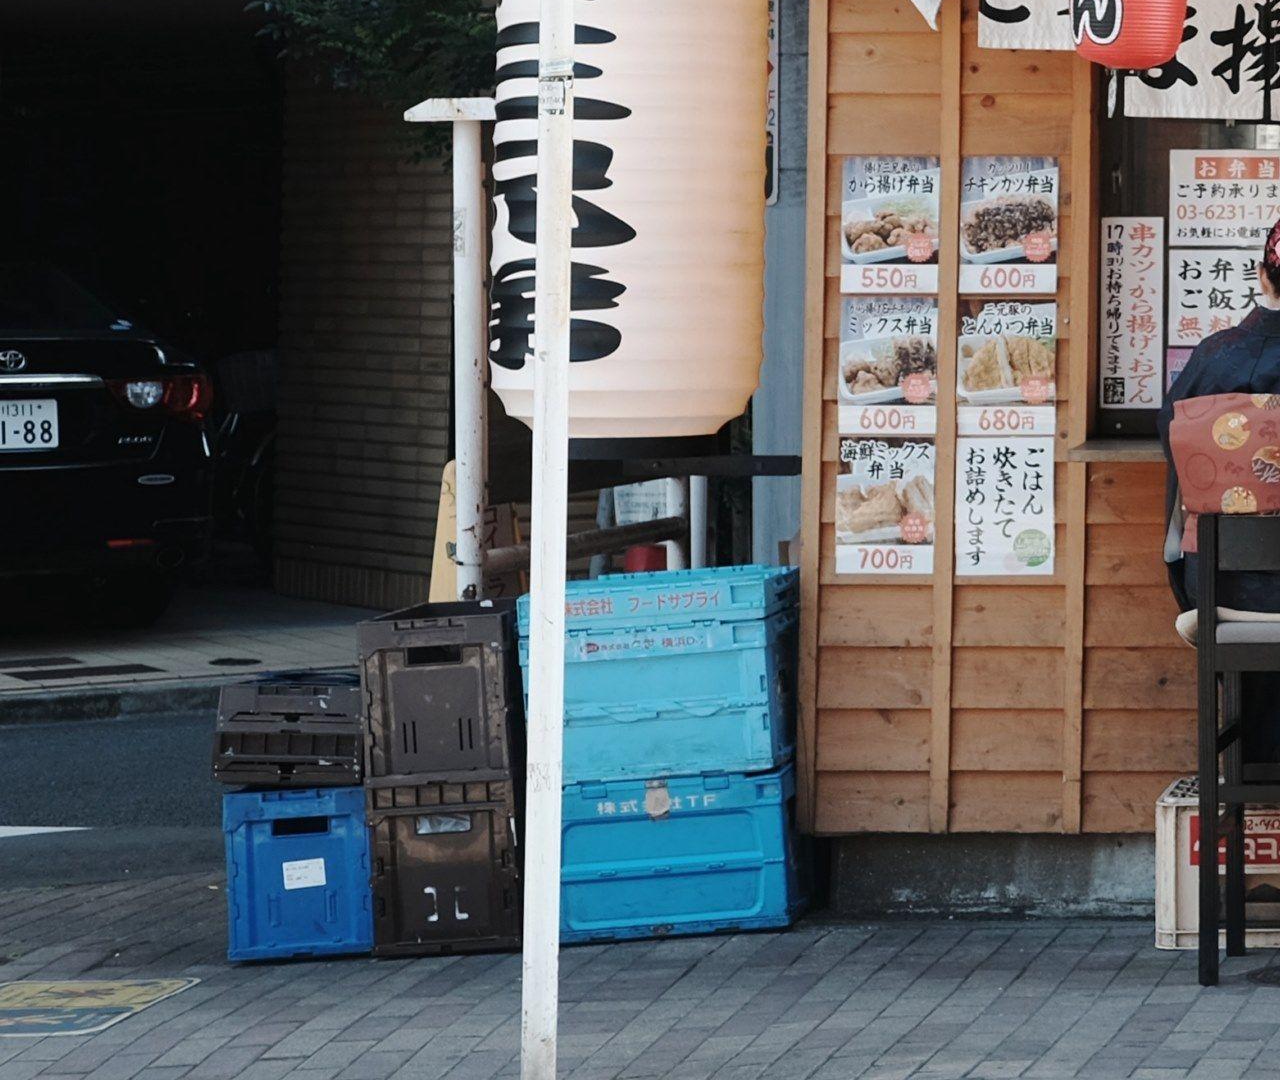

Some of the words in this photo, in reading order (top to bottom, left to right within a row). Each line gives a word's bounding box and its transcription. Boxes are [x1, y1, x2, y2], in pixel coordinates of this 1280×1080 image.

[1198, 157, 1277, 180] お弁当
[848, 175, 935, 195] から揚げ弁当
[964, 175, 1055, 194] チキンカツ弁当
[861, 267, 918, 289] 550円
[980, 267, 1036, 289] 600円
[983, 303, 1033, 316] 三元豚の
[847, 315, 933, 335] ミックス弁当
[962, 316, 1055, 336] とんかつ弁当
[859, 408, 916, 431] 600円
[978, 408, 1035, 431] 680円
[842, 441, 931, 461] 海鮮ミックス
[867, 461, 905, 480] 弁当
[1022, 446, 1045, 516] ごはん
[992, 445, 1018, 539] 炊きたて
[965, 446, 987, 567] お詰めします
[857, 547, 914, 570] 700円
